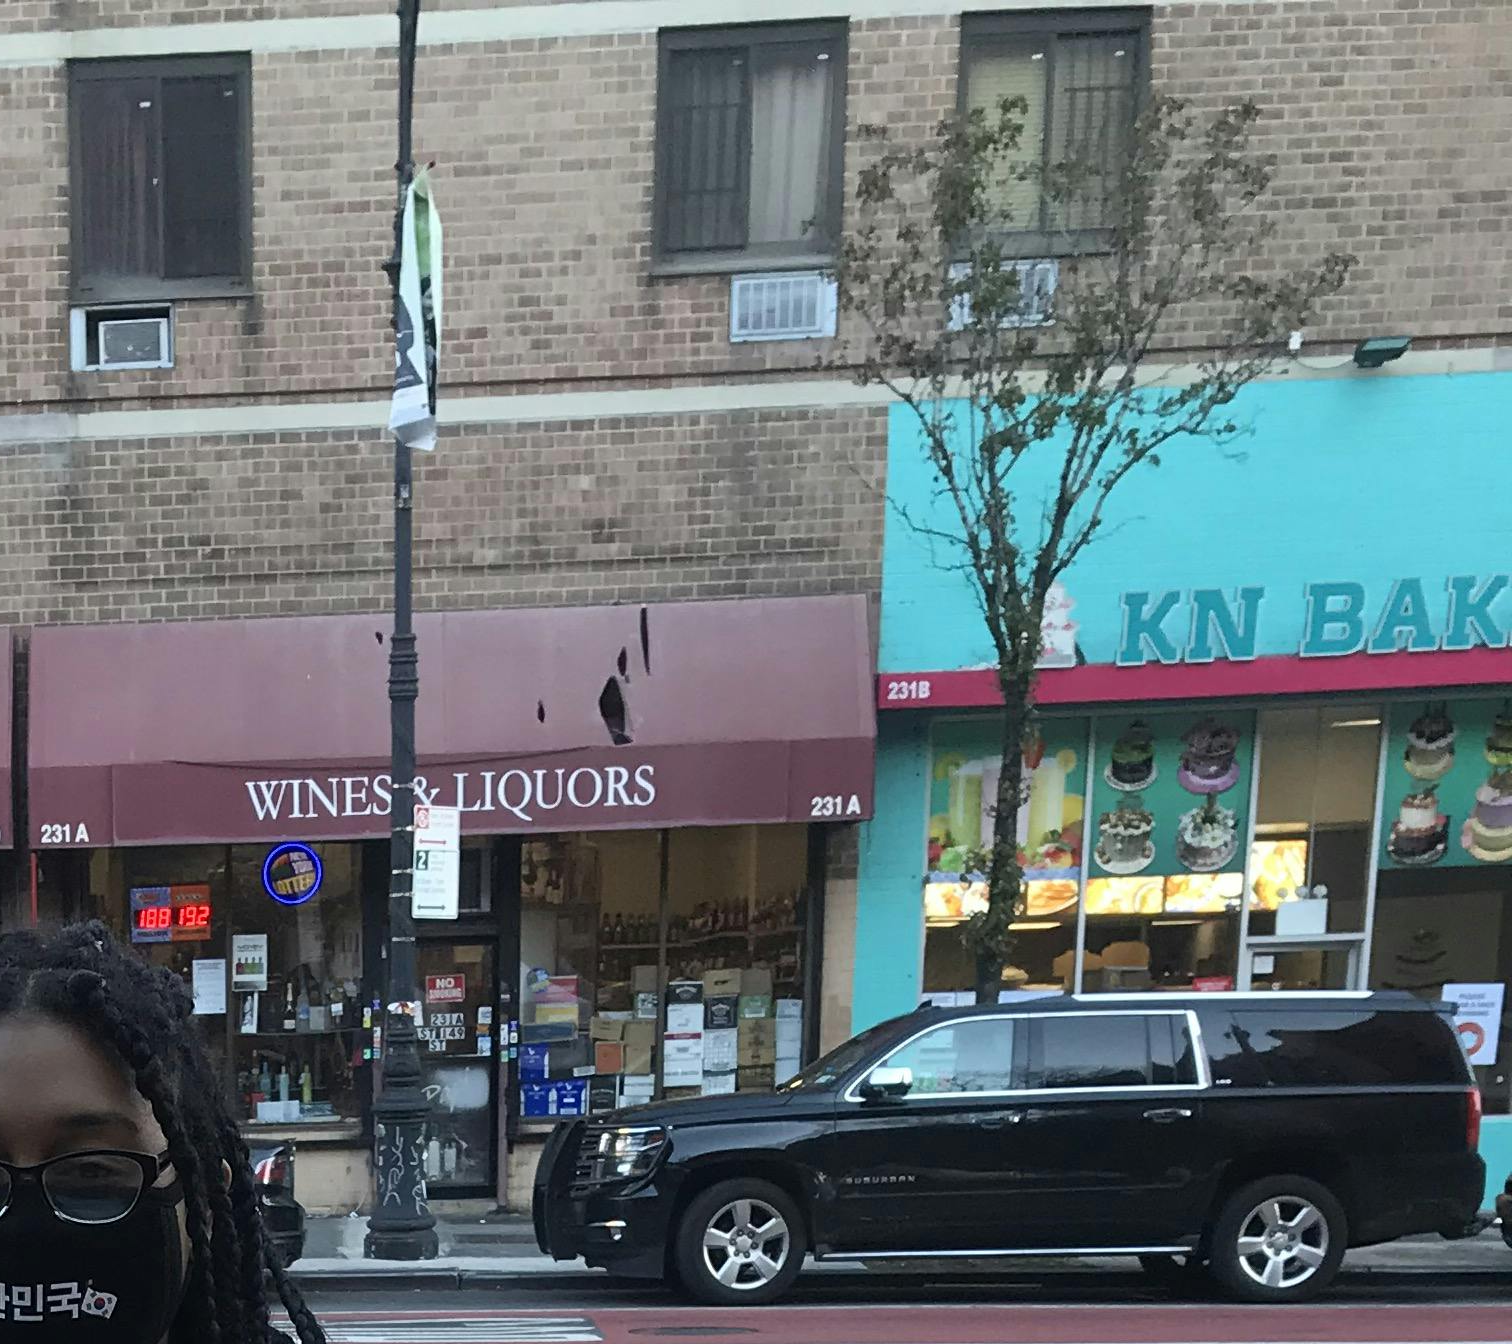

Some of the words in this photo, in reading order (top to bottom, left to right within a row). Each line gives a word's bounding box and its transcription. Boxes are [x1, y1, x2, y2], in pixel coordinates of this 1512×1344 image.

[1117, 588, 1265, 666] KN
[1301, 574, 1512, 658] BAK
[888, 681, 930, 700] 231B
[245, 775, 392, 821] WINES
[413, 776, 440, 805] &
[453, 764, 656, 821] LIQUORS
[811, 796, 843, 816] 231
[41, 824, 70, 843] 231
[139, 908, 171, 928] 188
[179, 906, 209, 926] 192
[436, 978, 455, 988] NO
[433, 1014, 463, 1025] 231A
